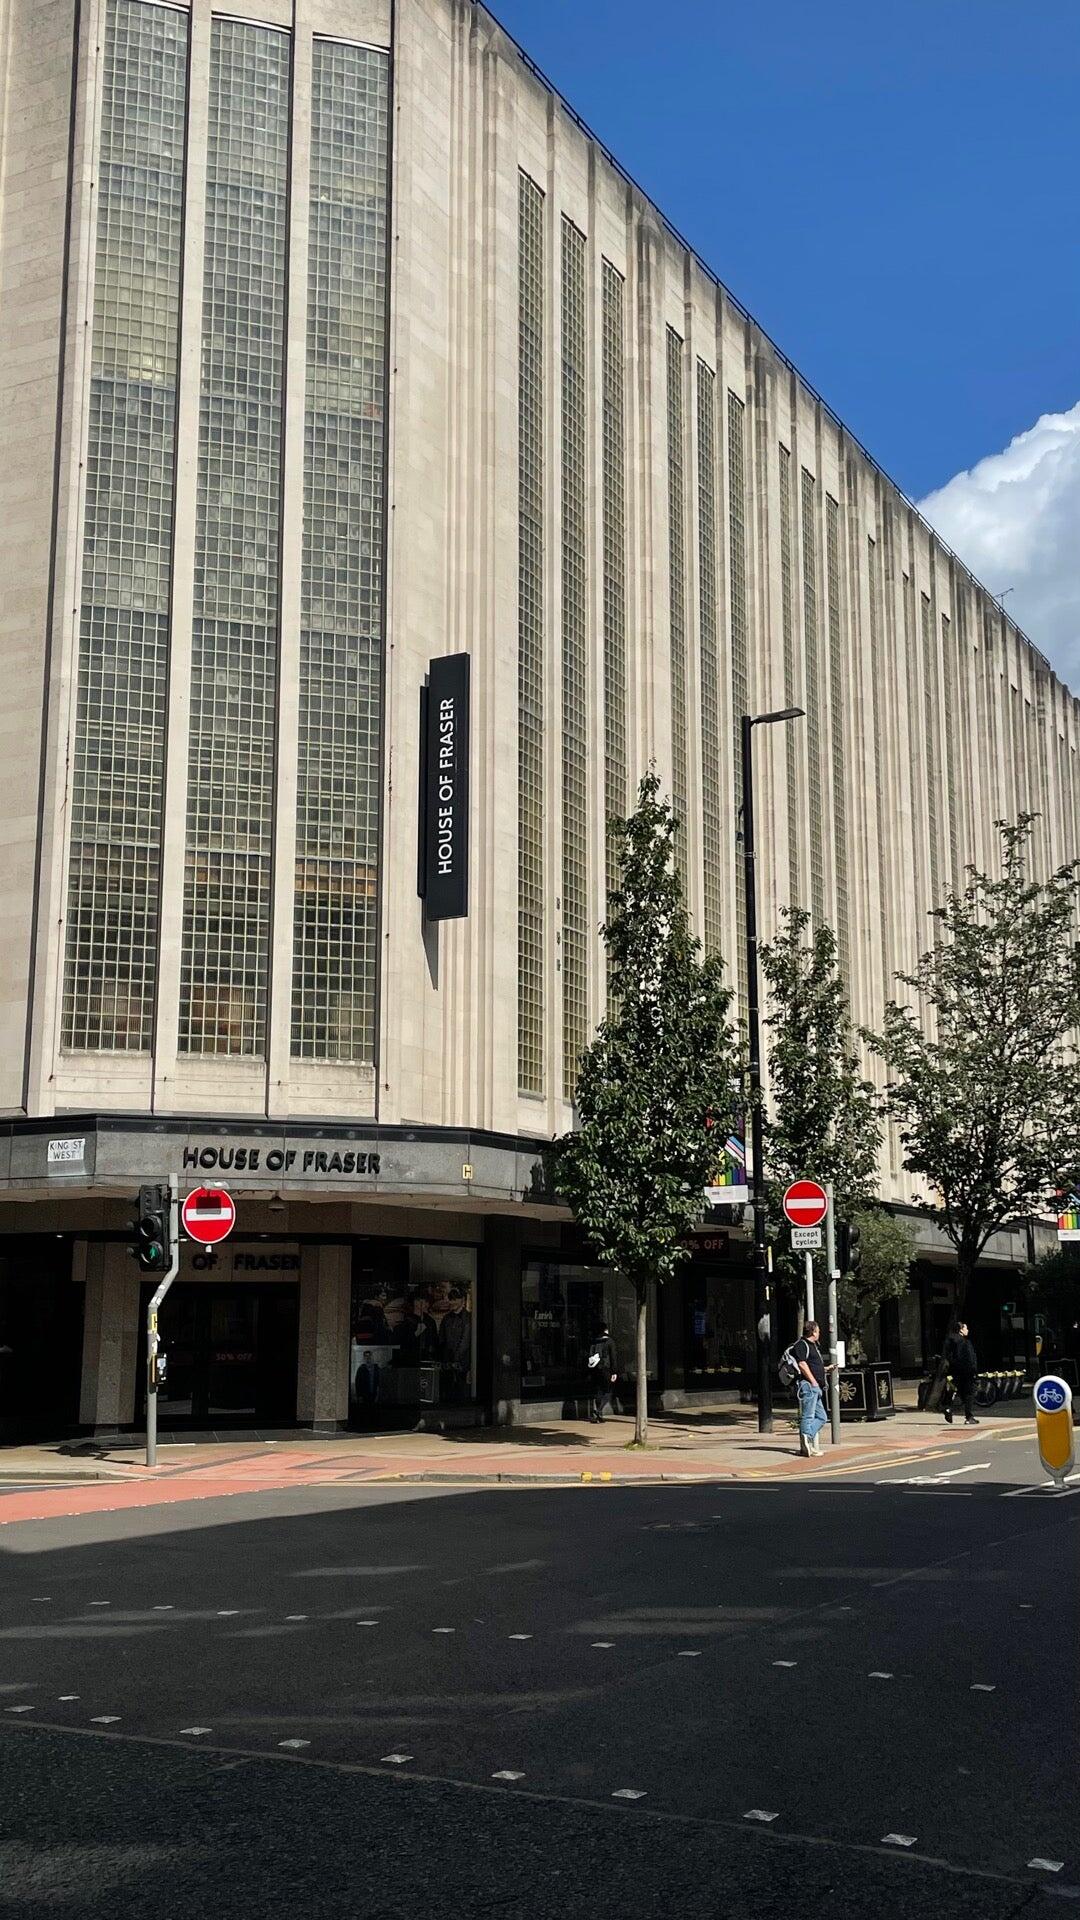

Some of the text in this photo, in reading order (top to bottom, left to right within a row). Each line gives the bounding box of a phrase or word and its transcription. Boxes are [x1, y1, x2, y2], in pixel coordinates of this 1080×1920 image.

[438, 697, 454, 875] HOUSE OF FRASER
[73, 1140, 83, 1149] ST
[53, 1150, 76, 1160] WEST
[183, 1146, 381, 1174] HOUSE OF FRASER
[464, 1166, 472, 1178] H
[678, 1239, 725, 1250] 0% OFF
[795, 1238, 818, 1246] cycles
[192, 1253, 303, 1270] OF FRASER
